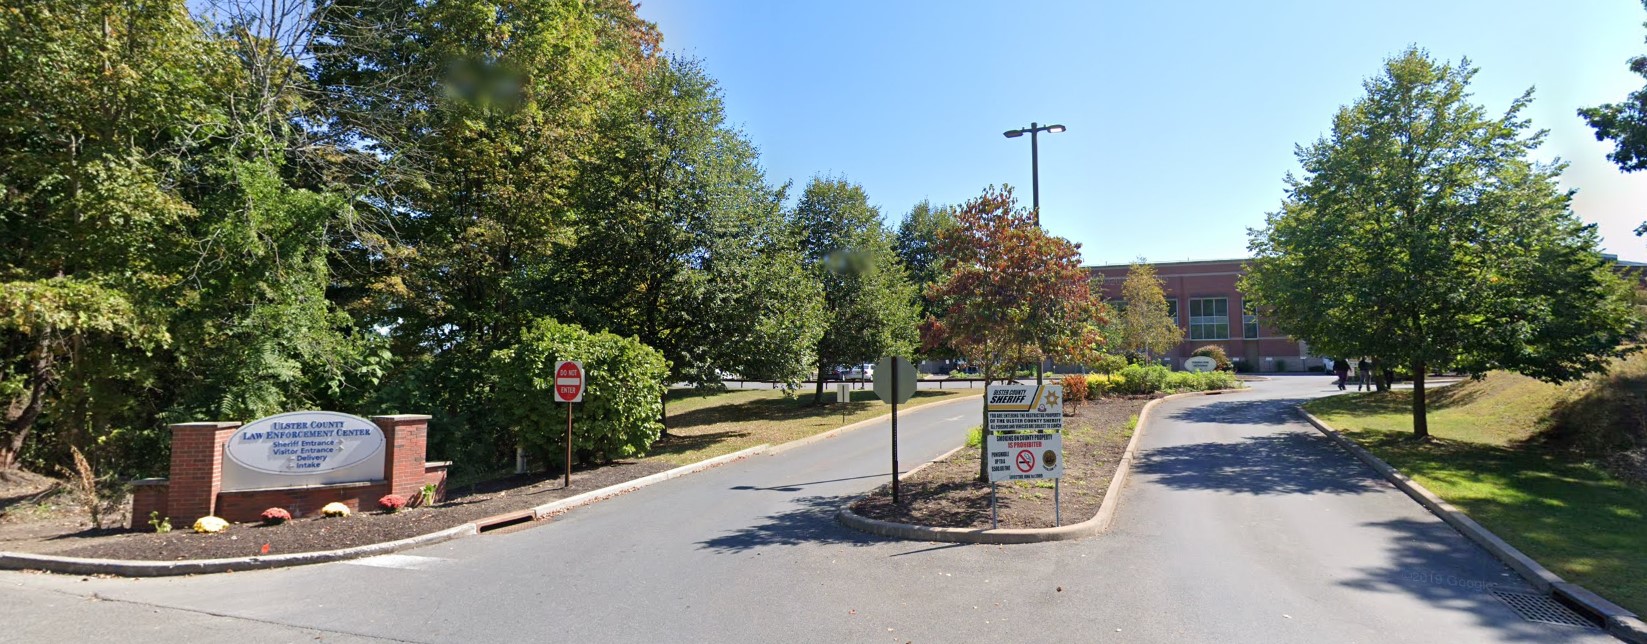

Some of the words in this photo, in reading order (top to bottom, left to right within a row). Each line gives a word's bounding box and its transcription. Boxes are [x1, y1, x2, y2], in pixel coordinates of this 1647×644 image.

[990, 395, 1026, 404] SHERIFF
[273, 422, 308, 430] ULSTER
[243, 432, 263, 440] LAW
[266, 430, 334, 439] ENFORCEMENT
[336, 428, 371, 437] CENTER
